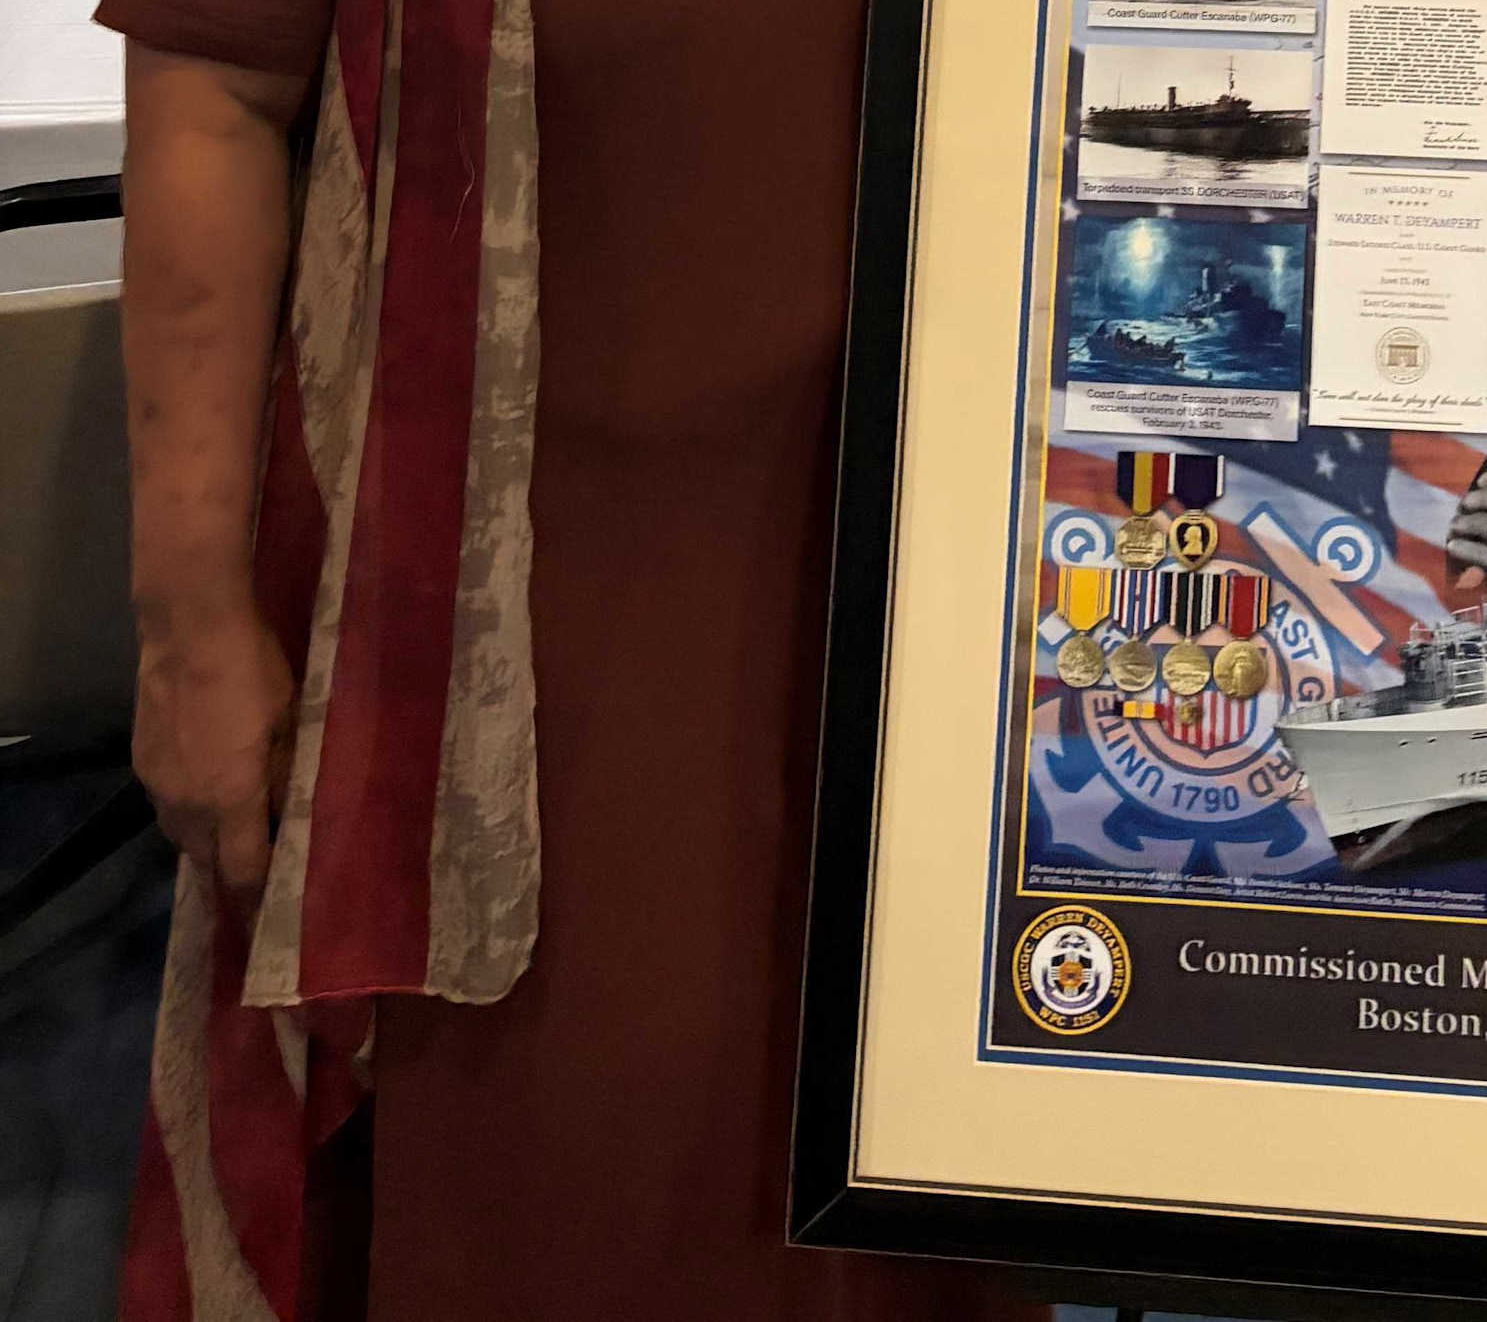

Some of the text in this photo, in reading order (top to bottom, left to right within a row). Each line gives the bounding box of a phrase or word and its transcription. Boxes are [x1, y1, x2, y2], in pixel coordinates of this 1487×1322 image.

[1107, 8, 1296, 24] Coast Guard Cutter Escanaba (WPG-77)
[1383, 187, 1433, 196] MEMORY
[1335, 212, 1389, 225] WARREN
[1405, 215, 1482, 229] DEYAMPERT
[1094, 695, 1165, 796] UNITE
[1172, 783, 1240, 813] 1790
[1179, 940, 1445, 988] Commissioned
